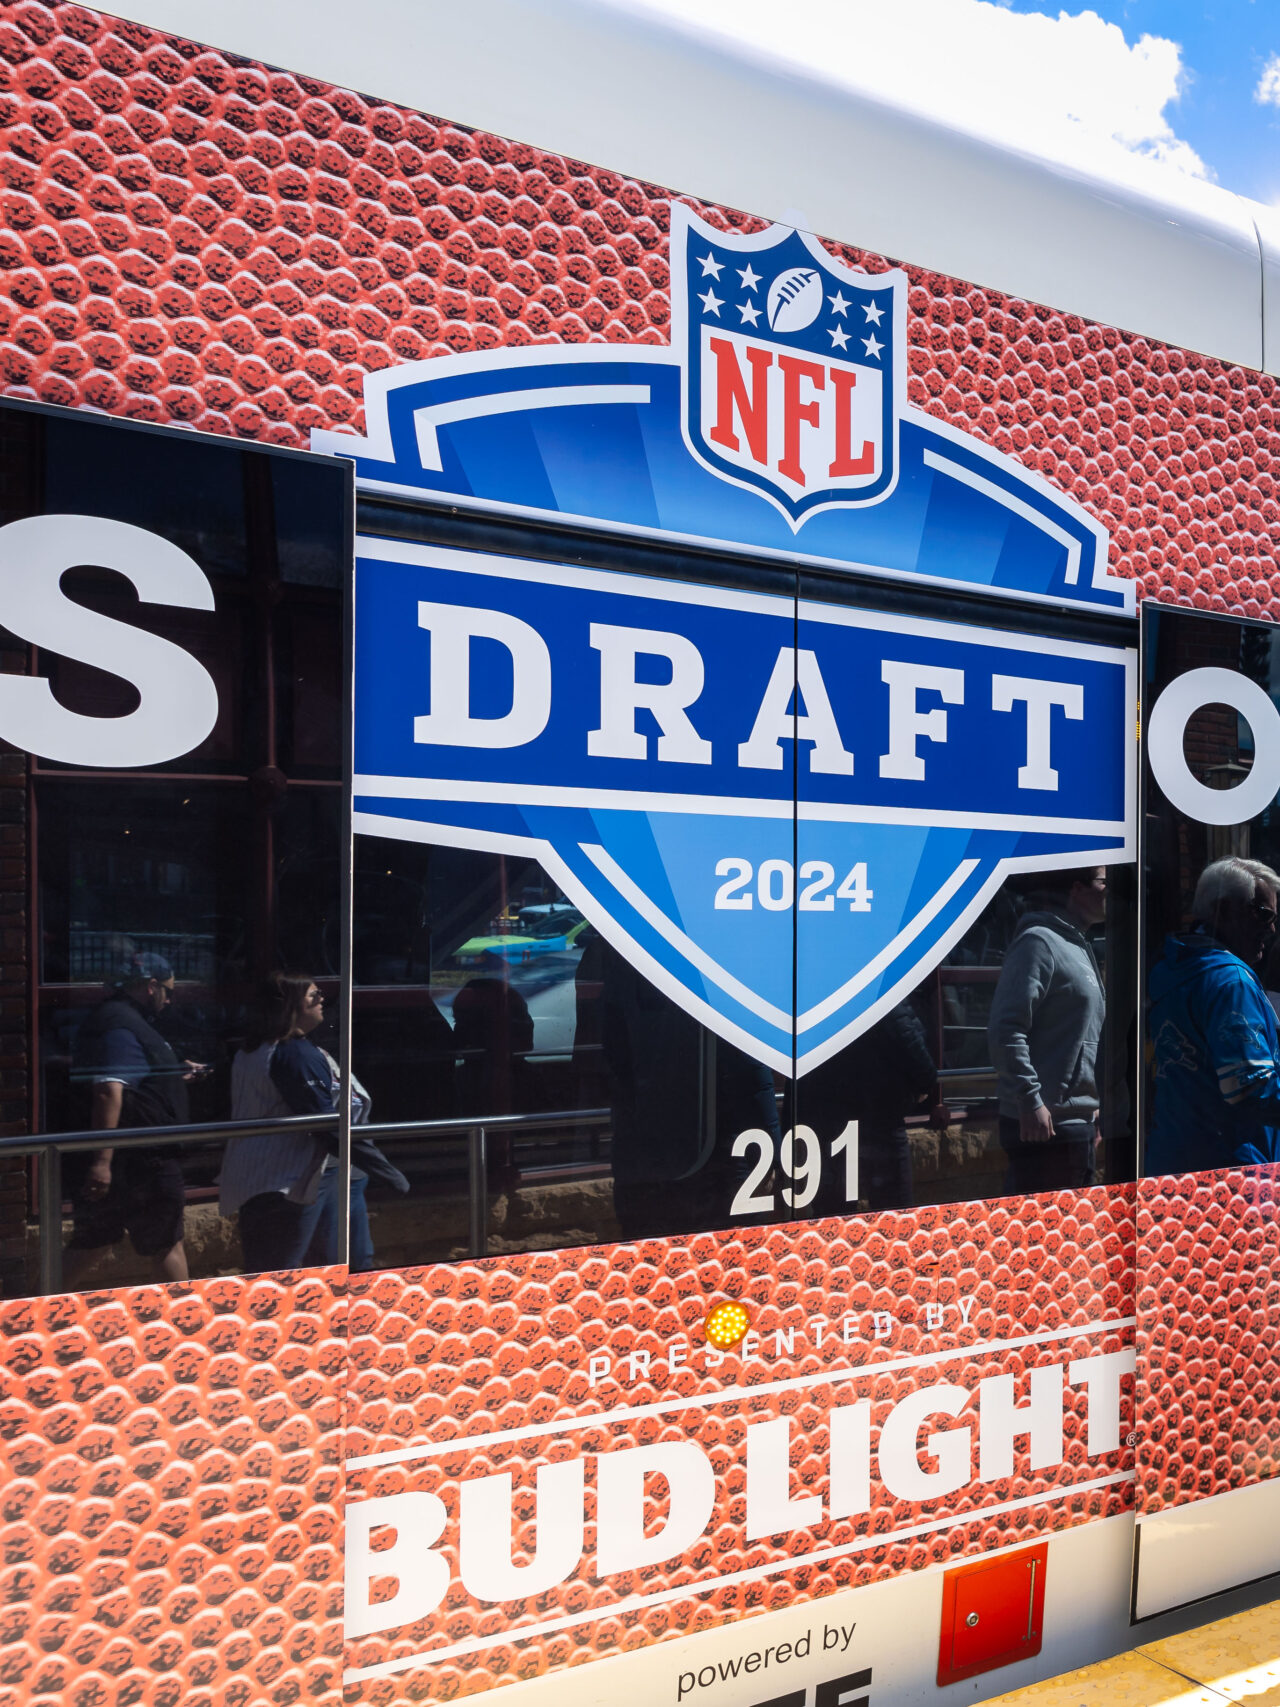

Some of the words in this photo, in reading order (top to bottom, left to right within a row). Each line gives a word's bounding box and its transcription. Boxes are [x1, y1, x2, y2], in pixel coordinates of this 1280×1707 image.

[709, 336, 876, 488] NFL
[413, 600, 1085, 792] DRAFT
[714, 857, 874, 914] 2024
[729, 1119, 859, 1217] 291
[588, 1310, 893, 1388] PRESENTED
[925, 1294, 975, 1332] BY
[344, 1440, 717, 1640] BUD
[746, 1348, 1137, 1542] LIGHT
[677, 1629, 812, 1703] powered
[822, 1622, 857, 1652] by
